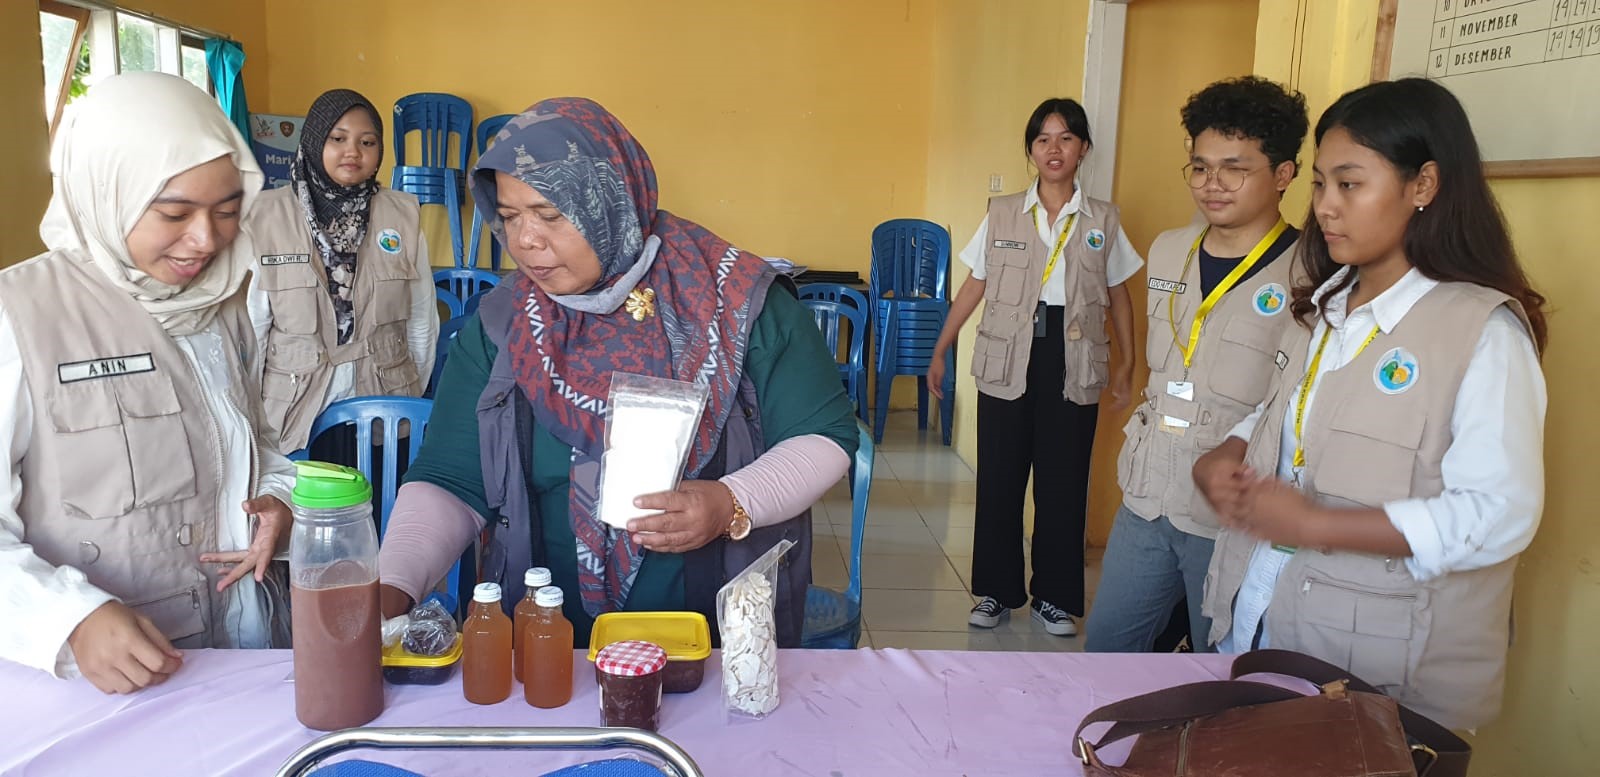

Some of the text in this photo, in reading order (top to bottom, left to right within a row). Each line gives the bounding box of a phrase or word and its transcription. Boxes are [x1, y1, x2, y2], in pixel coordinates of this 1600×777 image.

[1460, 13, 1518, 37] NOVEMBER
[1436, 54, 1443, 68] 12
[1454, 46, 1512, 66] DESEMBER
[1568, 28, 1584, 48] 14
[265, 154, 291, 165] Mari
[88, 360, 127, 376] ANIN
